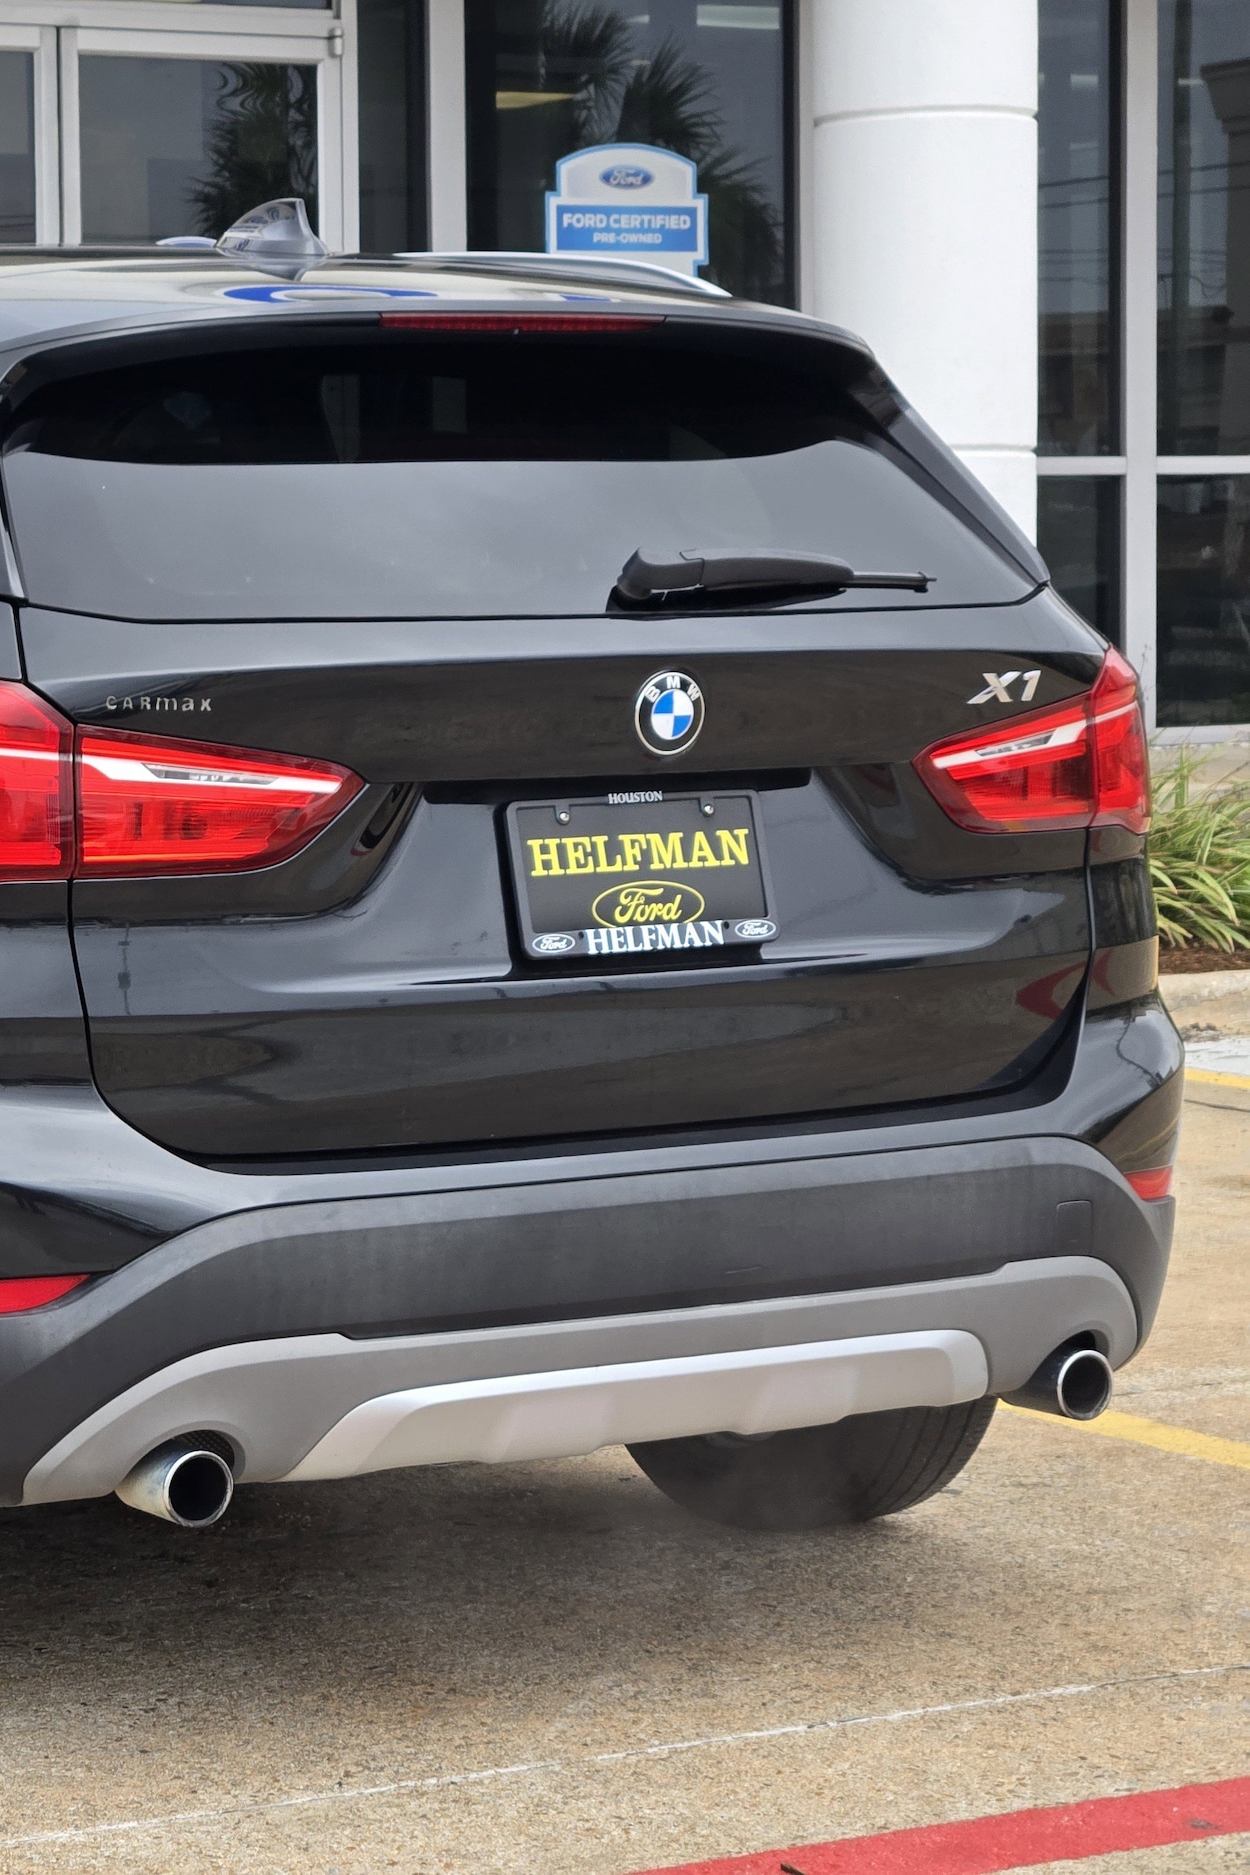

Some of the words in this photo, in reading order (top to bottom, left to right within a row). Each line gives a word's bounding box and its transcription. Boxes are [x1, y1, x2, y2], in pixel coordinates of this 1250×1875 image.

[609, 169, 644, 185] Ford
[562, 213, 607, 229] FORD
[609, 214, 691, 230] CERTIFIED
[593, 232, 662, 244] PRE-OWNED
[644, 676, 701, 702] BMW
[967, 670, 1041, 705] X1
[607, 791, 663, 805] HOUSTON
[526, 828, 750, 877] HELFMAN
[614, 887, 682, 923] Ford
[540, 935, 568, 950] Ford
[585, 920, 725, 955] HELFMAN
[741, 922, 770, 936] Ford
